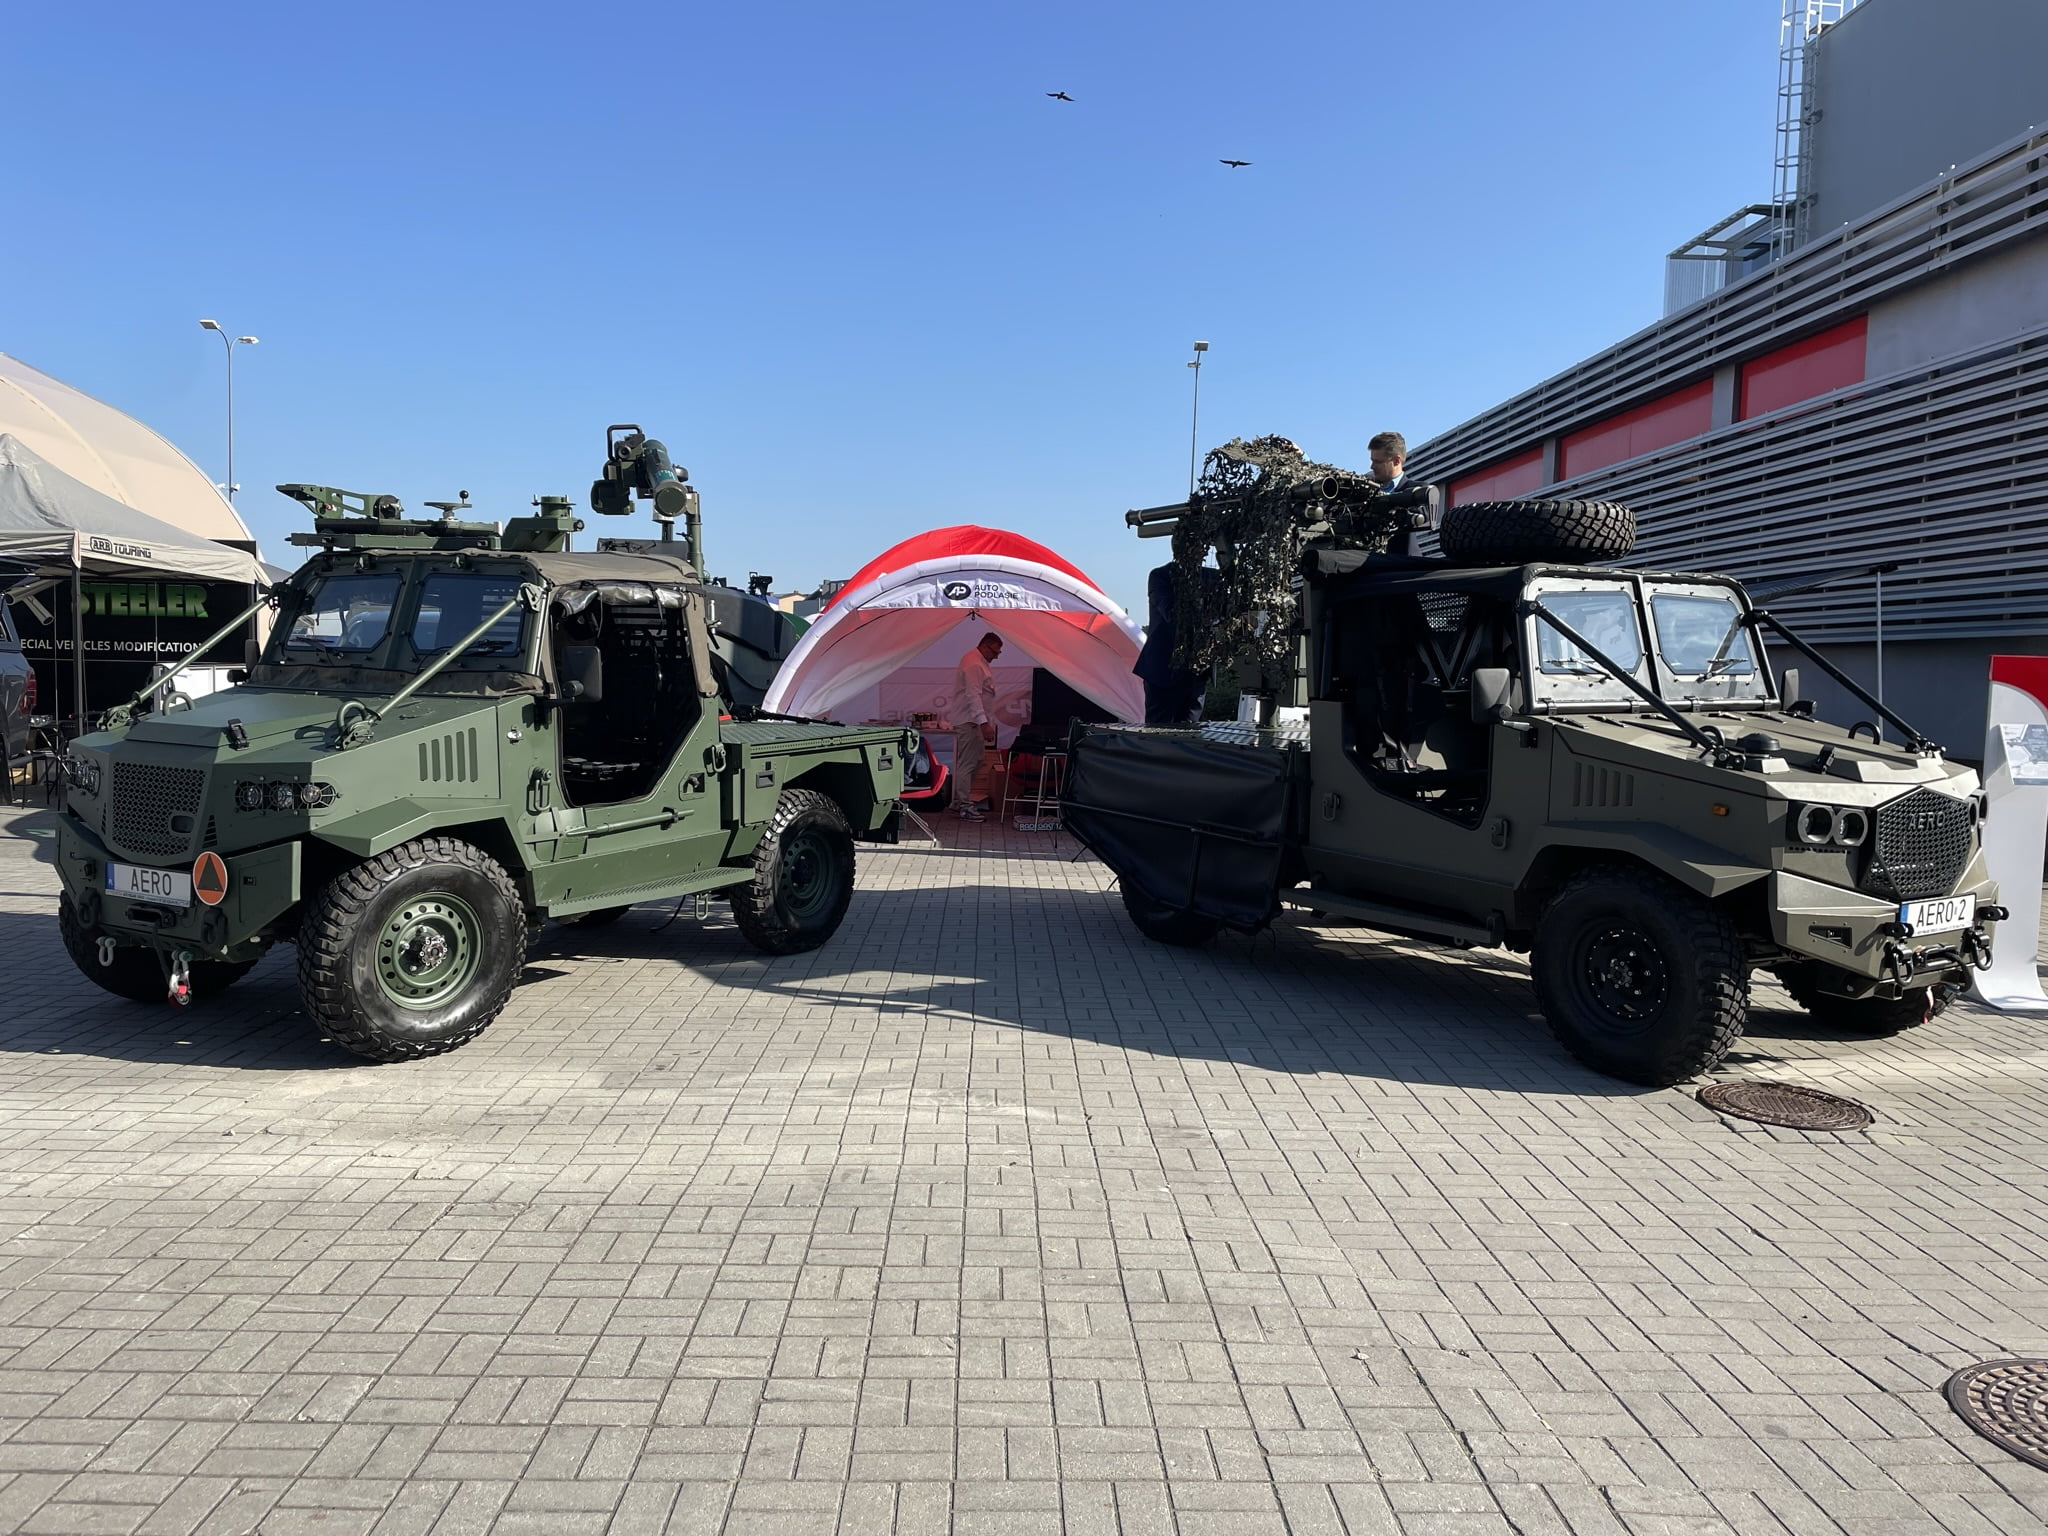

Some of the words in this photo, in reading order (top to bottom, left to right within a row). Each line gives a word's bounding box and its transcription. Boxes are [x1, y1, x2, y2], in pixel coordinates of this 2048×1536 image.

[92, 539, 110, 552] ARB
[113, 542, 152, 559] TOURING
[974, 591, 1019, 600] PODLASIE
[20, 638, 53, 650] ECIAL
[114, 641, 209, 653] MODIFICATION
[1908, 811, 1946, 831] AERO
[130, 868, 172, 896] AERO
[1916, 900, 1954, 928] AERO
[1957, 898, 1967, 921] 2
